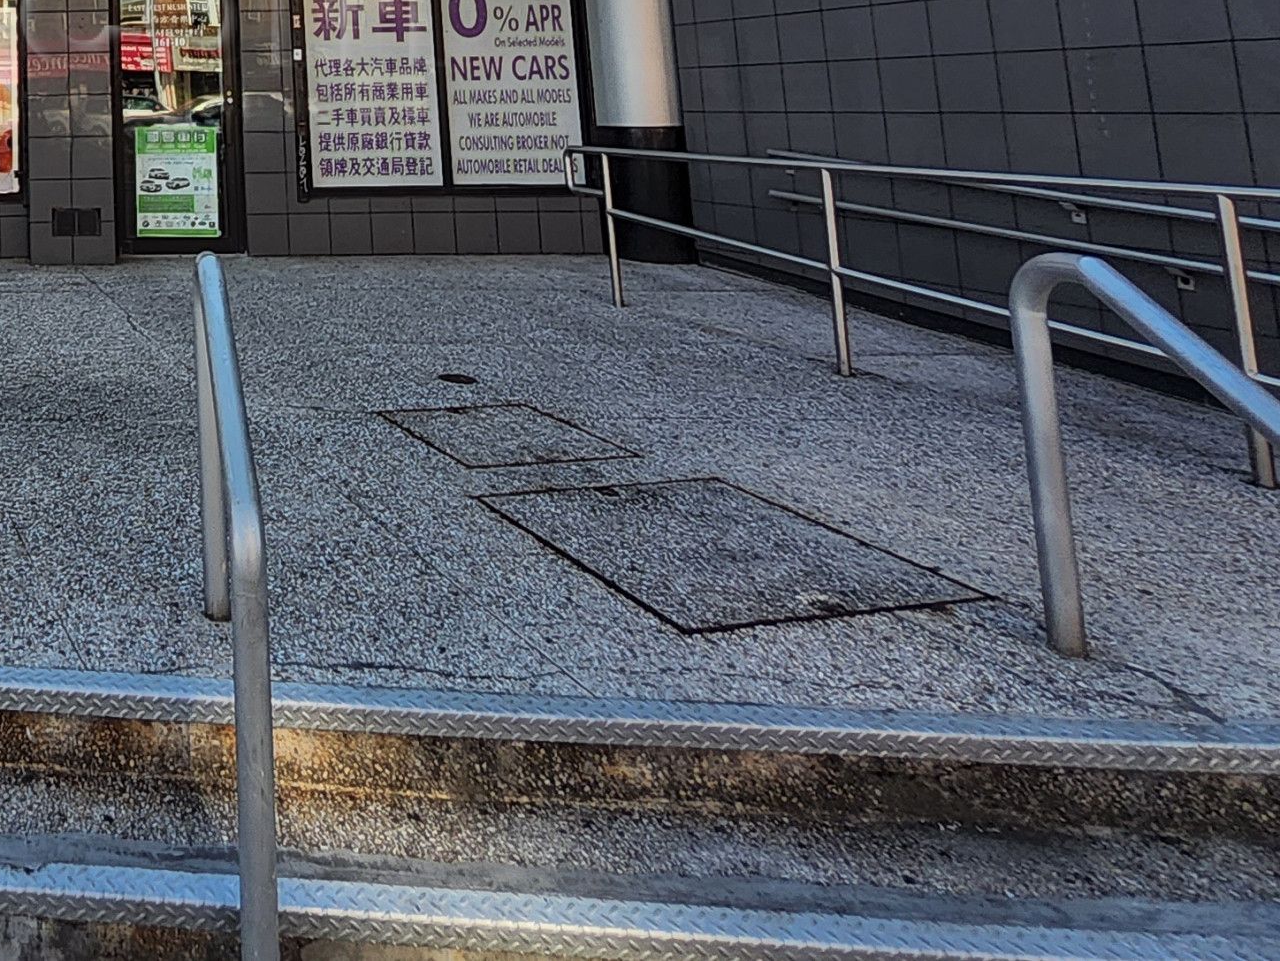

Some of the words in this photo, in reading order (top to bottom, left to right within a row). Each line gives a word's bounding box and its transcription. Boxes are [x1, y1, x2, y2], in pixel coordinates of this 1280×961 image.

[525, 4, 564, 32] APR
[494, 37, 505, 48] On
[507, 36, 537, 48] Selected
[539, 36, 566, 47] Models
[314, 56, 428, 77] 代理各大汽車品牌
[450, 56, 503, 81] NEW
[511, 54, 570, 81] CARS
[316, 82, 429, 102] 包括所有商業用車
[453, 90, 467, 105] ALL
[469, 89, 497, 105] MAKES
[500, 89, 518, 104] AND
[521, 89, 535, 104] ALL
[537, 88, 571, 104] MODELS
[468, 112, 482, 128] WE
[484, 112, 500, 127] ARE
[502, 111, 558, 127] AUTOMOBILE
[459, 135, 514, 151] CONSULTING
[516, 135, 549, 151] BROKER
[550, 135, 569, 150] NOT
[320, 156, 434, 178] 領牌及交通局登記
[456, 159, 511, 175] AUTOMOBILE
[514, 158, 541, 174] RETAIL
[542, 157, 579, 174] DEALS
